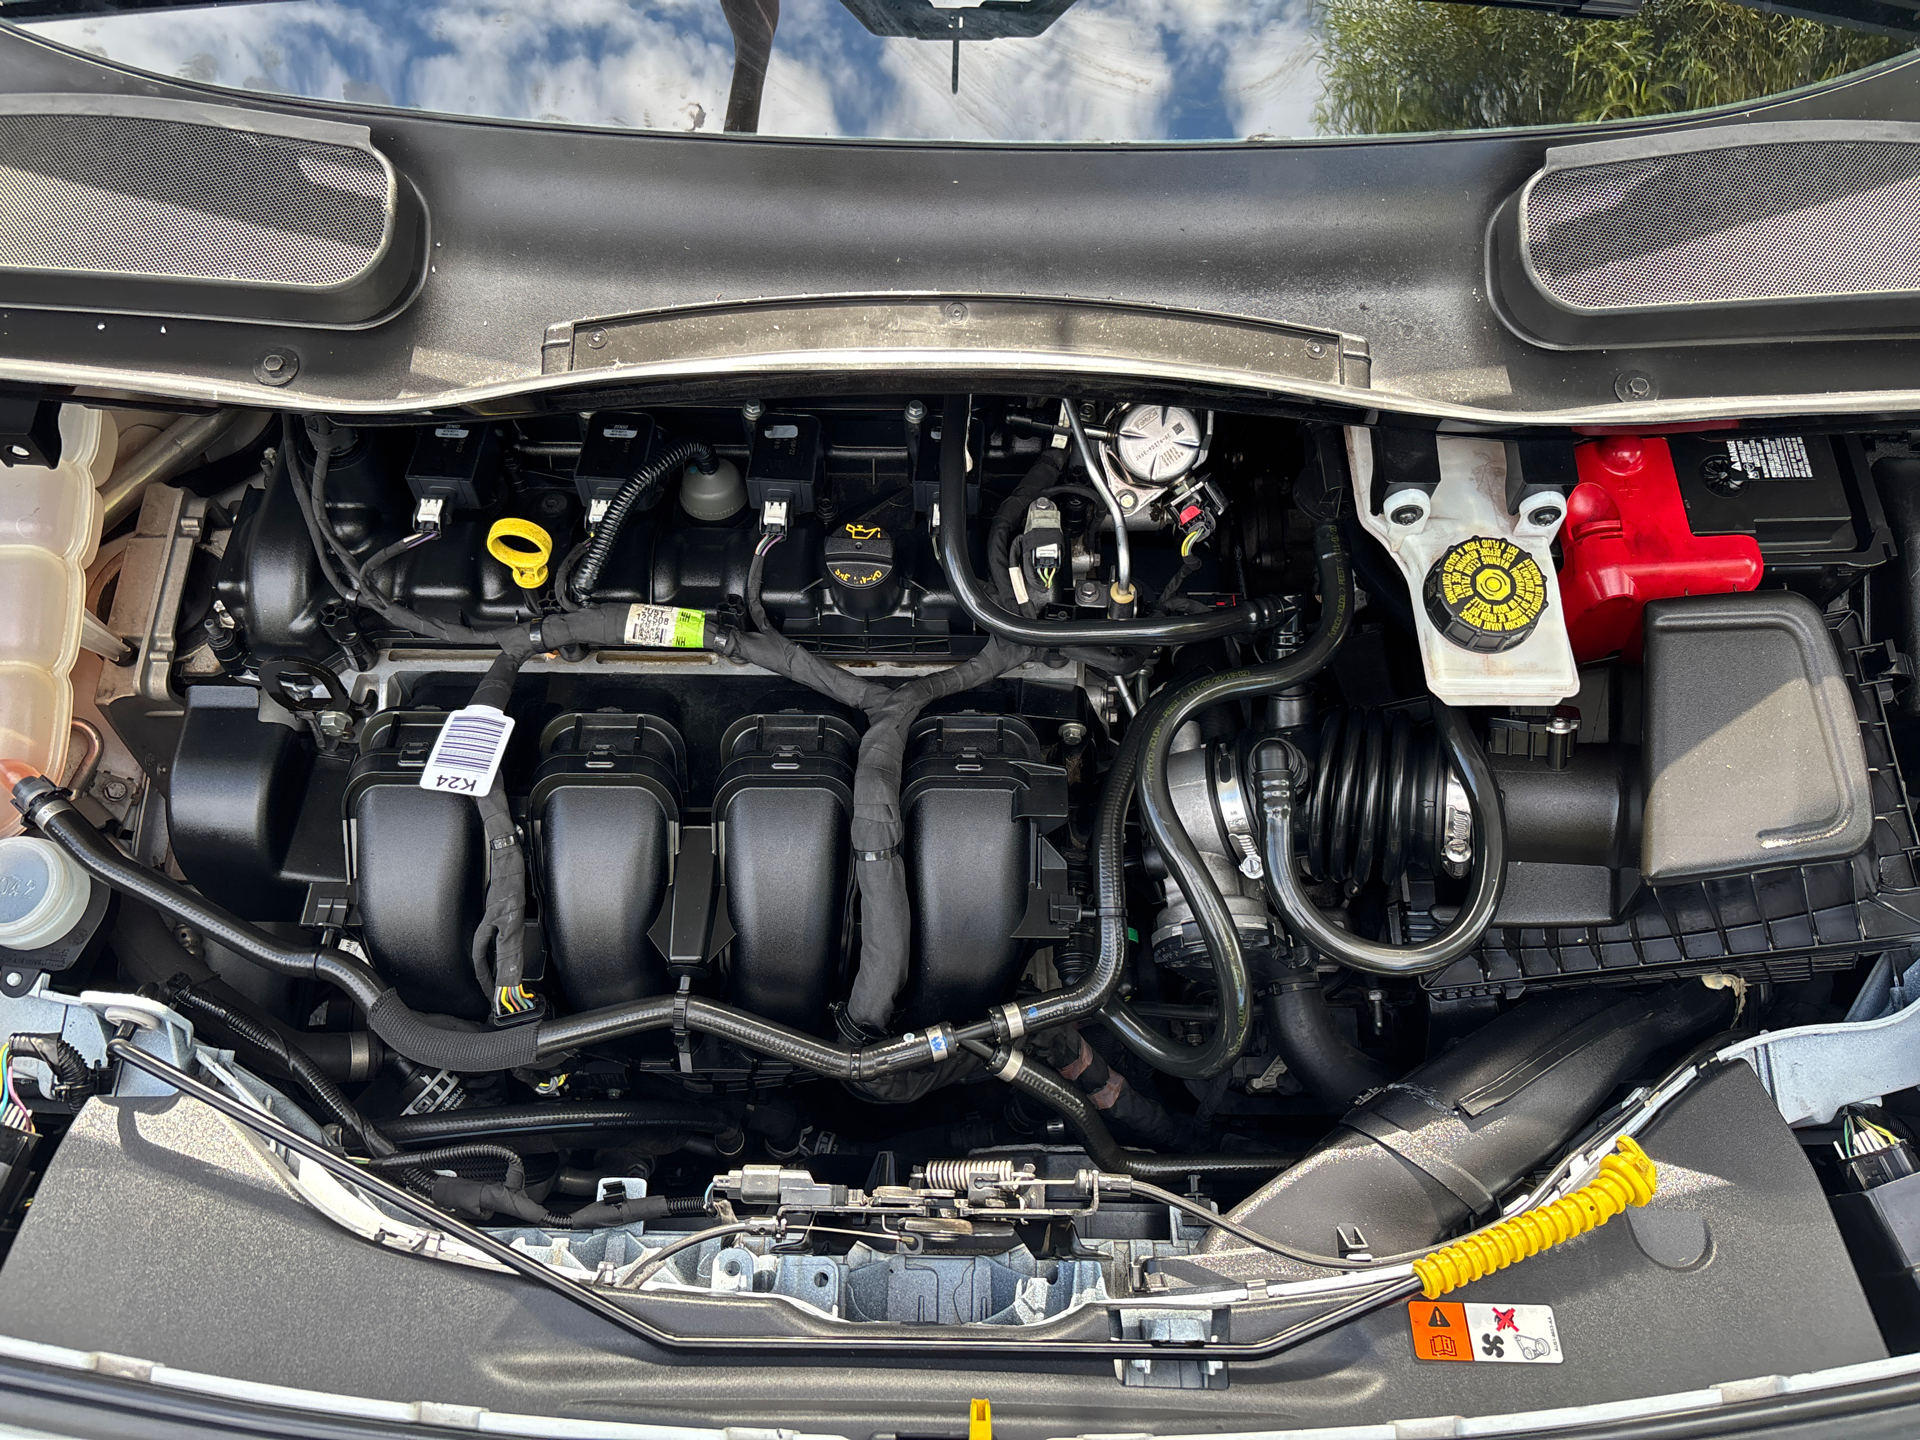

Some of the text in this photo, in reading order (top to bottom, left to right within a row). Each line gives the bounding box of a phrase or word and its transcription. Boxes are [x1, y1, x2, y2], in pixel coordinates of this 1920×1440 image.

[1726, 440, 1738, 461] DANGE
[1463, 541, 1480, 553] FROM
[1481, 540, 1499, 549] FLUID
[1506, 546, 1519, 556] DOT
[1444, 552, 1460, 572] SEALED
[1452, 546, 1515, 601] CAP BEFORE REMOVING USE ONLY
[1461, 555, 1513, 597] WARNING CLEAN FILLER
[1442, 573, 1458, 604] CONTAINER
[636, 613, 669, 626] 12C508
[680, 611, 692, 622] NH
[676, 636, 686, 646] NH
[436, 774, 477, 792] K24
